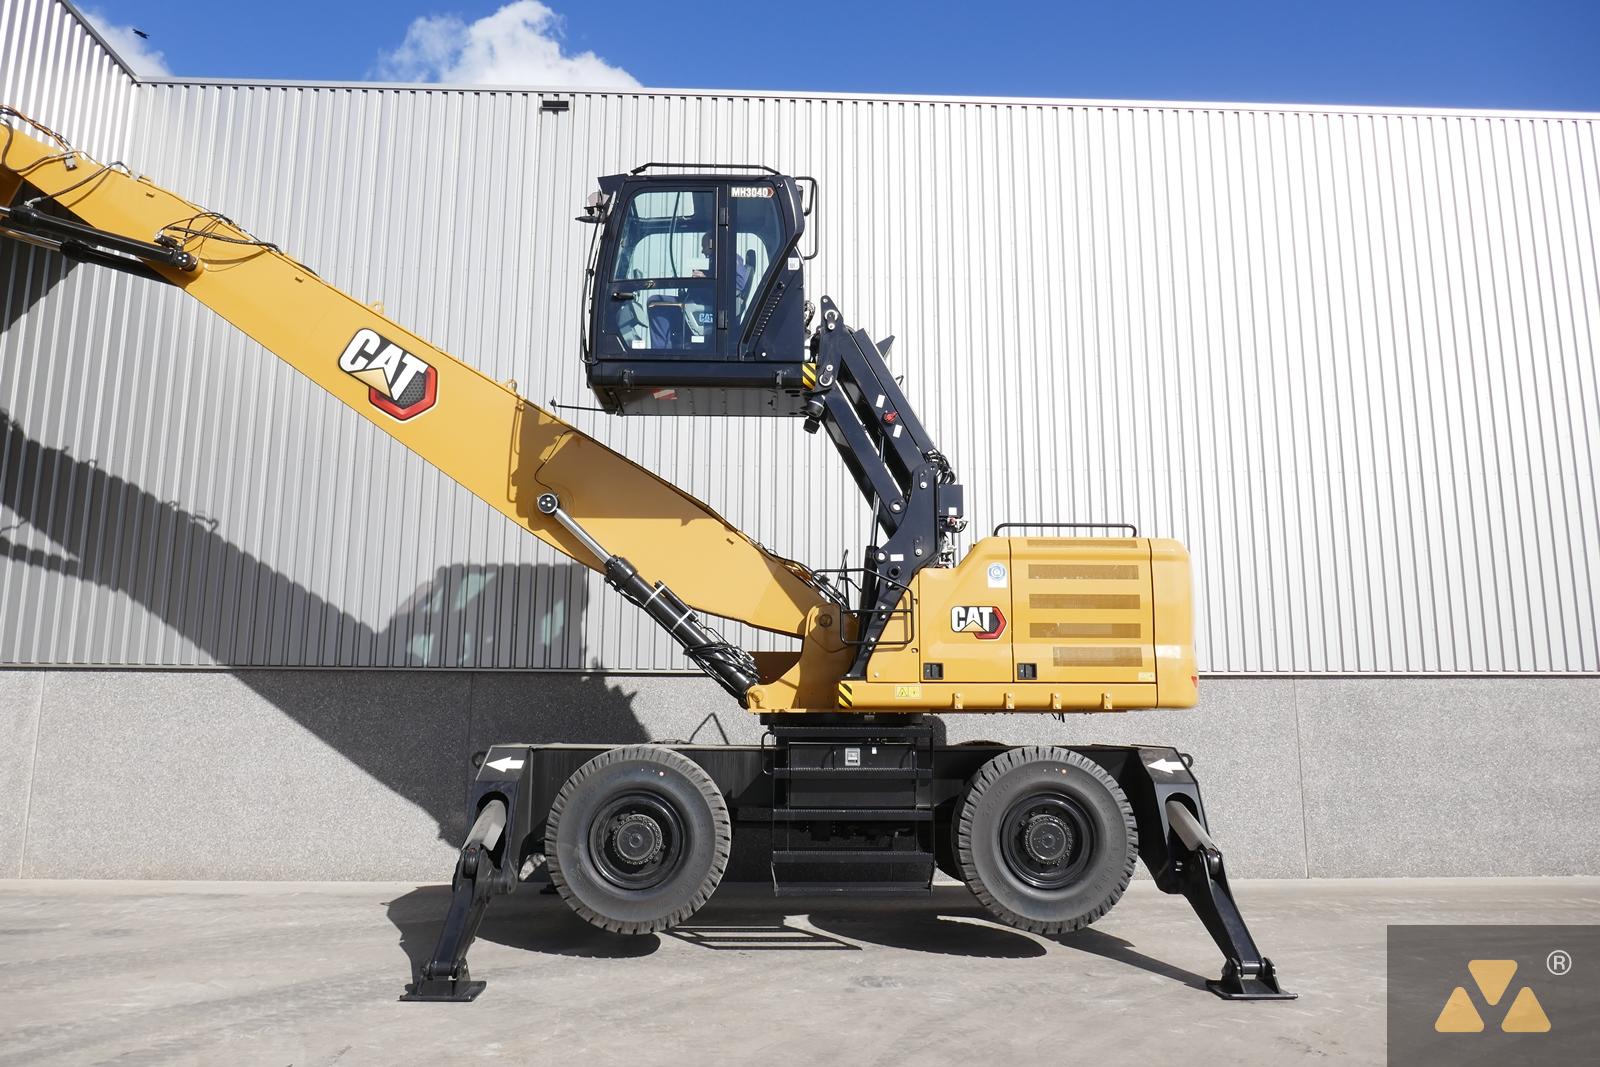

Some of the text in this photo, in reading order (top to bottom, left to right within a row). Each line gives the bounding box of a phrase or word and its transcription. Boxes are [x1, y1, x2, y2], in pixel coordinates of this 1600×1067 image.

[731, 187, 768, 198] MH3040
[339, 328, 429, 401] CAT
[951, 606, 994, 632] CAT
